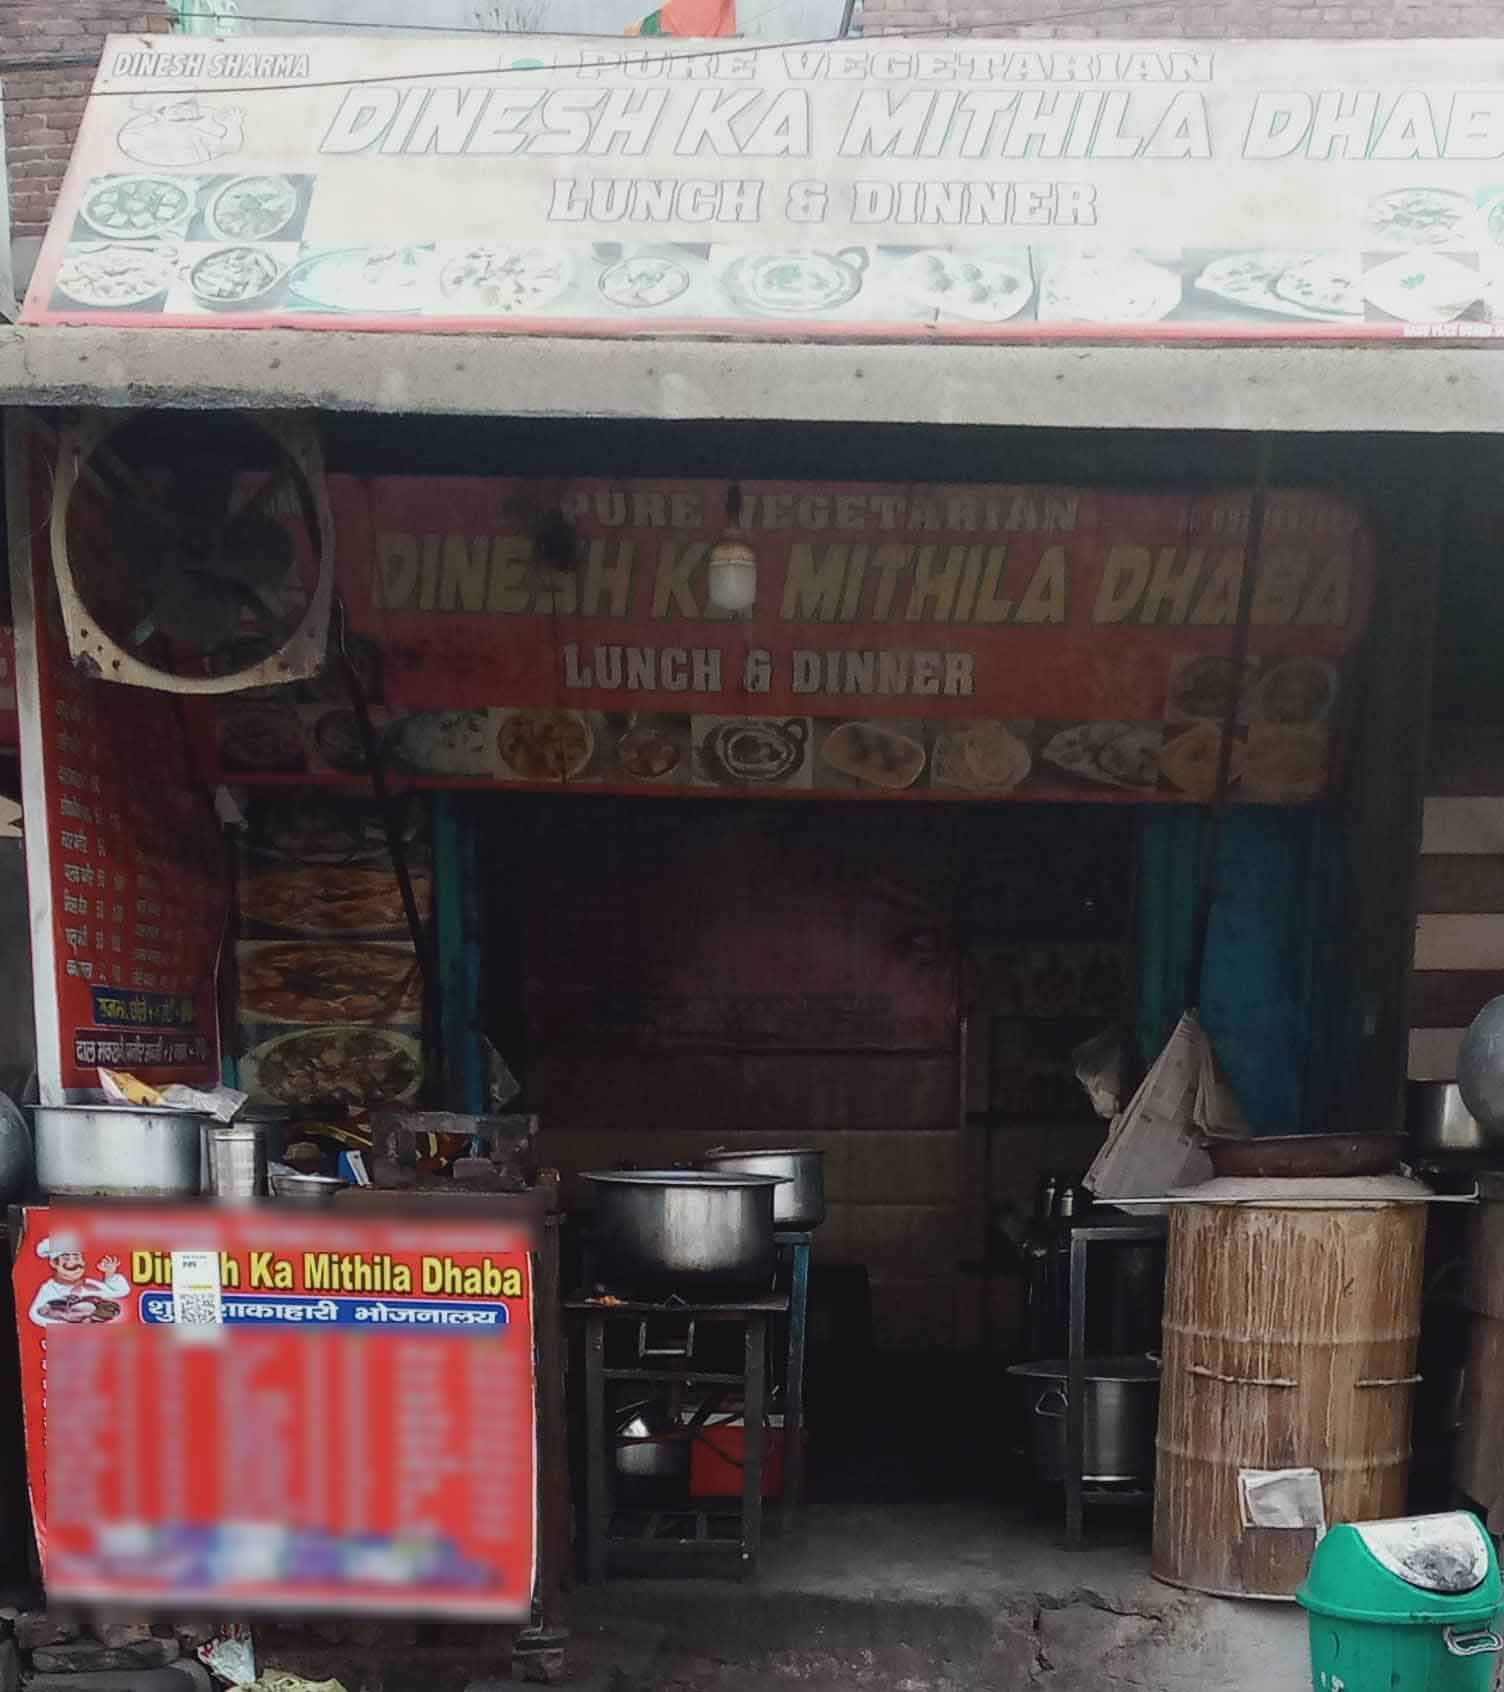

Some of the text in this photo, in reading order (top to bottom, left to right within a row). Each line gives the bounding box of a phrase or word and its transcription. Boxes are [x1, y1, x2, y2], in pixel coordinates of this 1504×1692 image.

[112, 52, 310, 79] DINESH SHARMA
[577, 48, 1215, 82] PURE VEGETARIAN
[319, 86, 670, 156] DINESH
[672, 87, 810, 157] KA
[837, 88, 1213, 159] MITHILA
[547, 178, 1099, 226] LUNCH & DINNER
[652, 540, 755, 621] K
[779, 543, 1068, 625] MITHILA
[563, 643, 977, 697] LUNCH & DINNER
[250, 1251, 293, 1289] Ka
[303, 1253, 412, 1294] Mithila
[421, 1256, 523, 1297] Dhaba
[354, 1303, 500, 1325] भोजनालय
